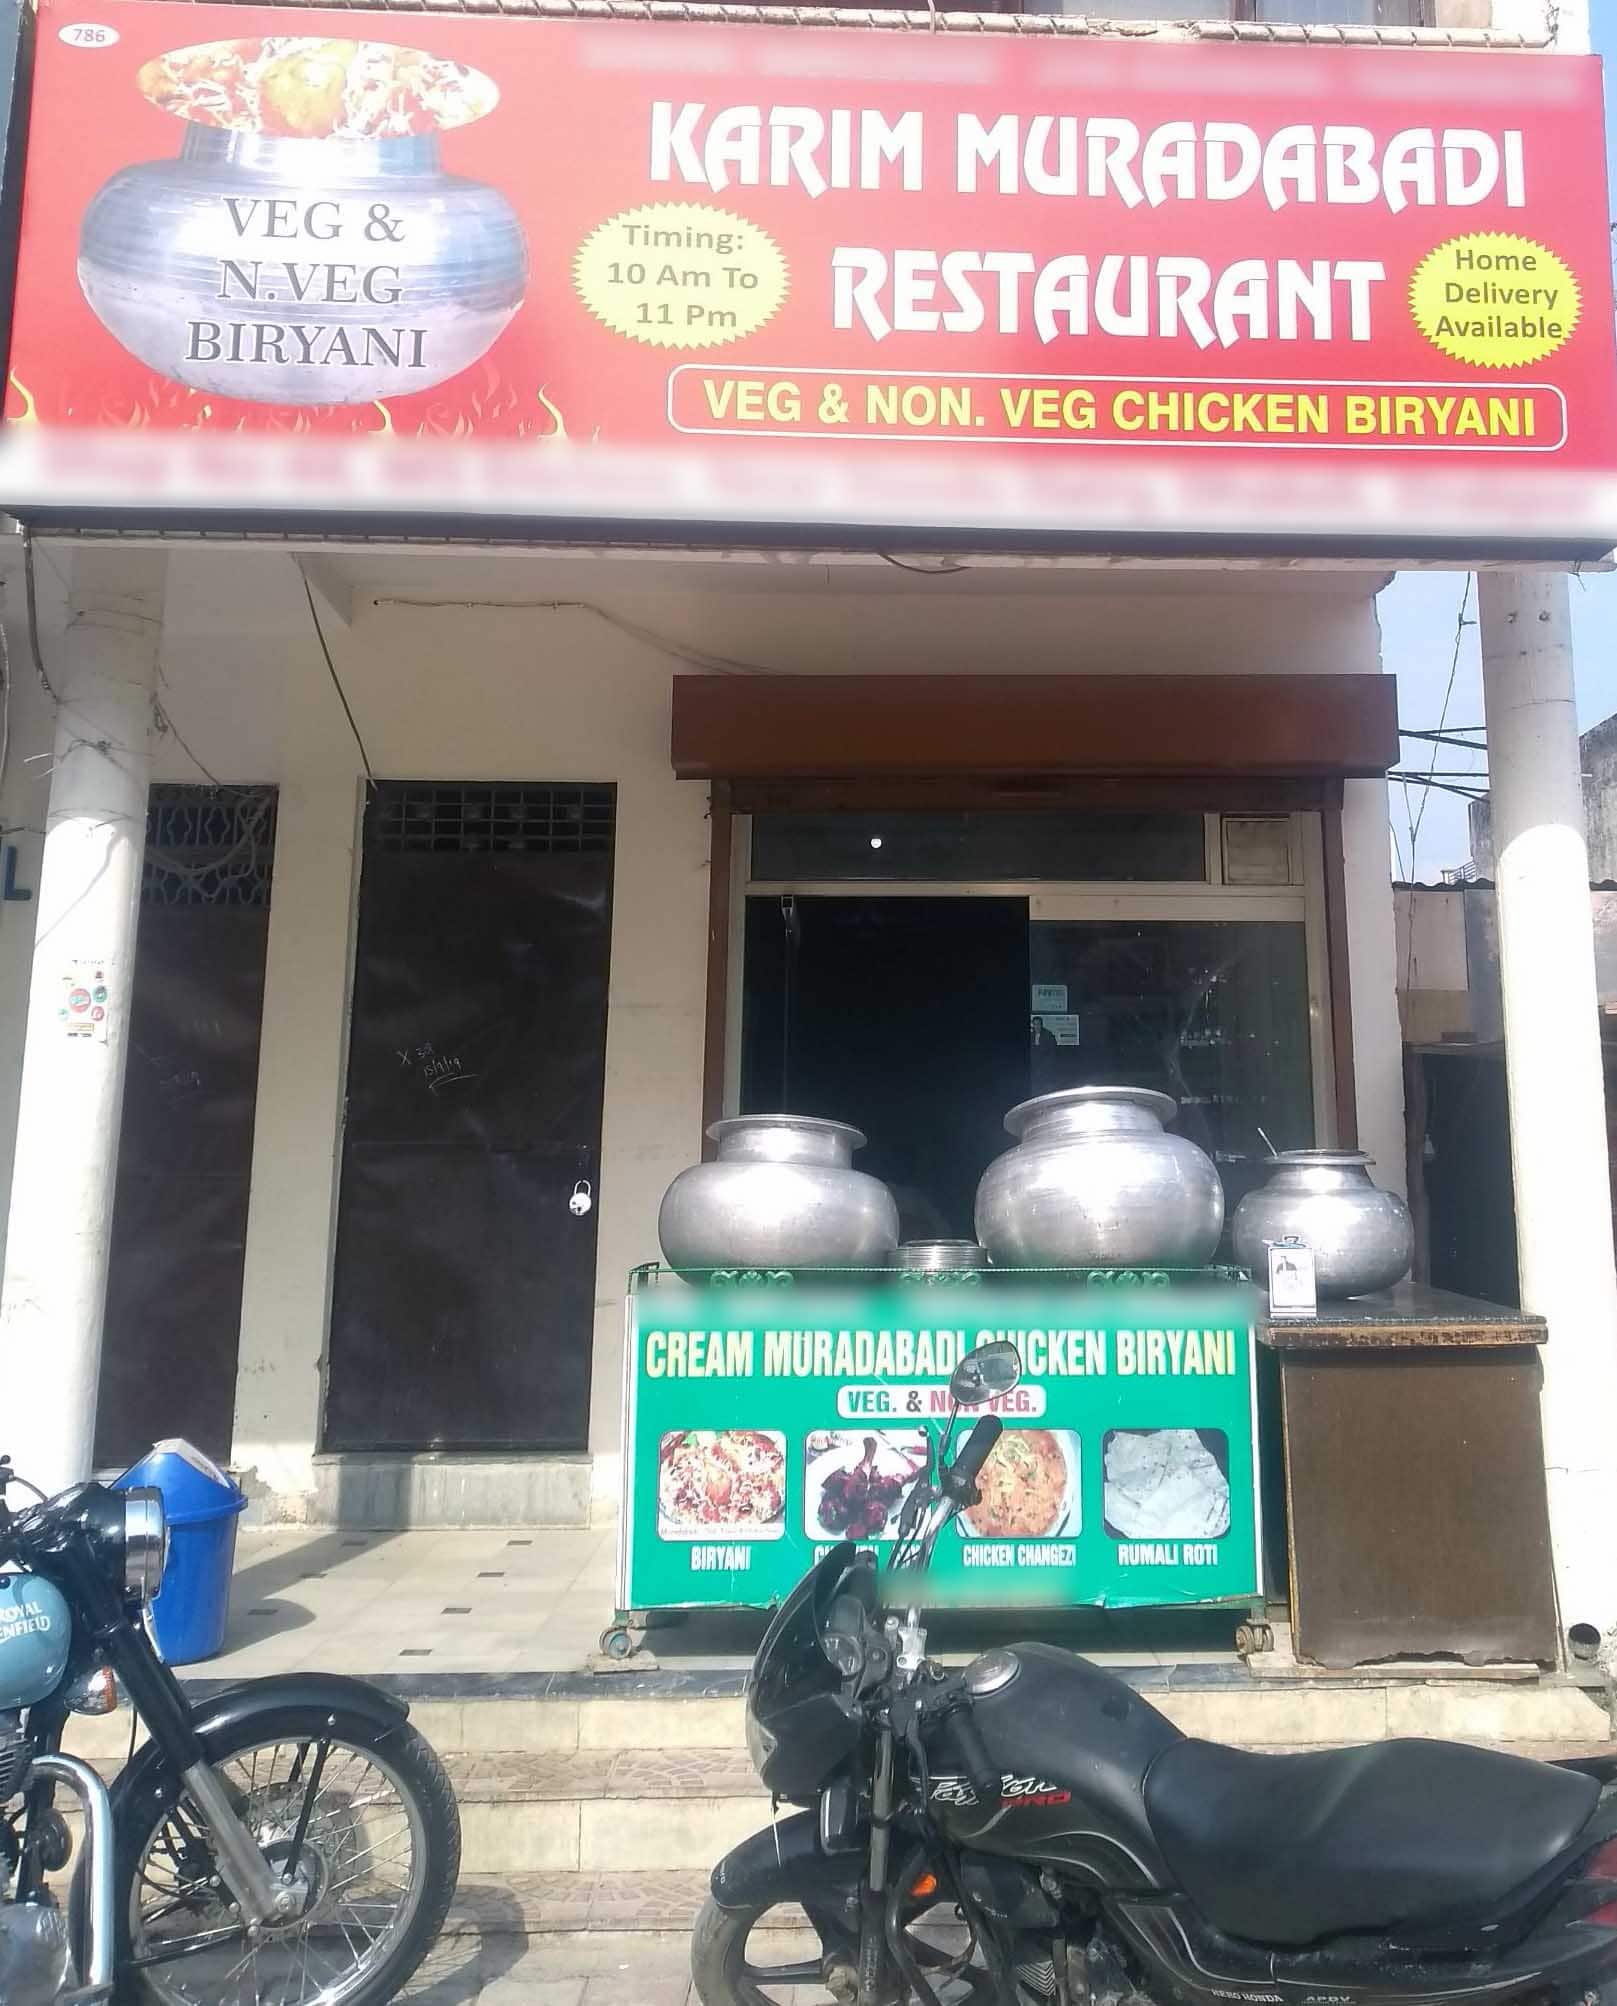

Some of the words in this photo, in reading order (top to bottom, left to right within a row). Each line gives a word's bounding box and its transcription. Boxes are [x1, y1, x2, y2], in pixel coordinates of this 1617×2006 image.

[73, 28, 106, 43] 786
[649, 100, 928, 200] KARIM
[955, 112, 1527, 214] MURADABADI
[224, 197, 341, 241] VEG
[364, 202, 406, 243] &
[622, 223, 744, 253] Timing:
[1454, 248, 1537, 272] Home
[217, 259, 404, 305] N.VEG
[608, 262, 646, 286] 10
[656, 264, 712, 289] Am
[722, 266, 759, 290] To
[831, 246, 1387, 351] RESTAURANT
[1444, 281, 1558, 311] Delivery
[636, 302, 672, 326] 11
[686, 304, 737, 328] Pm
[1435, 315, 1562, 340] Available
[185, 320, 429, 368] BIRYANI
[703, 379, 802, 423] VEG
[817, 384, 849, 425] &
[866, 385, 984, 427] NON.
[1000, 388, 1097, 430] VEG
[1112, 390, 1329, 434] CHICKEN
[1346, 395, 1536, 437] BIRYANI
[646, 1330, 754, 1378] CREAM
[764, 1329, 966, 1377] MURADABADI
[1116, 1329, 1237, 1376] BIRYANI
[848, 1390, 897, 1412] VEG.
[906, 1391, 922, 1412] &
[690, 1545, 751, 1571] BIRYANI
[963, 1544, 1014, 1567] CHICKEN
[1017, 1544, 1076, 1567] CHANGEZI
[1118, 1543, 1179, 1566] RUMALI
[1183, 1543, 1218, 1566] ROTI
[1242, 1992, 1284, 2003] HONDA
